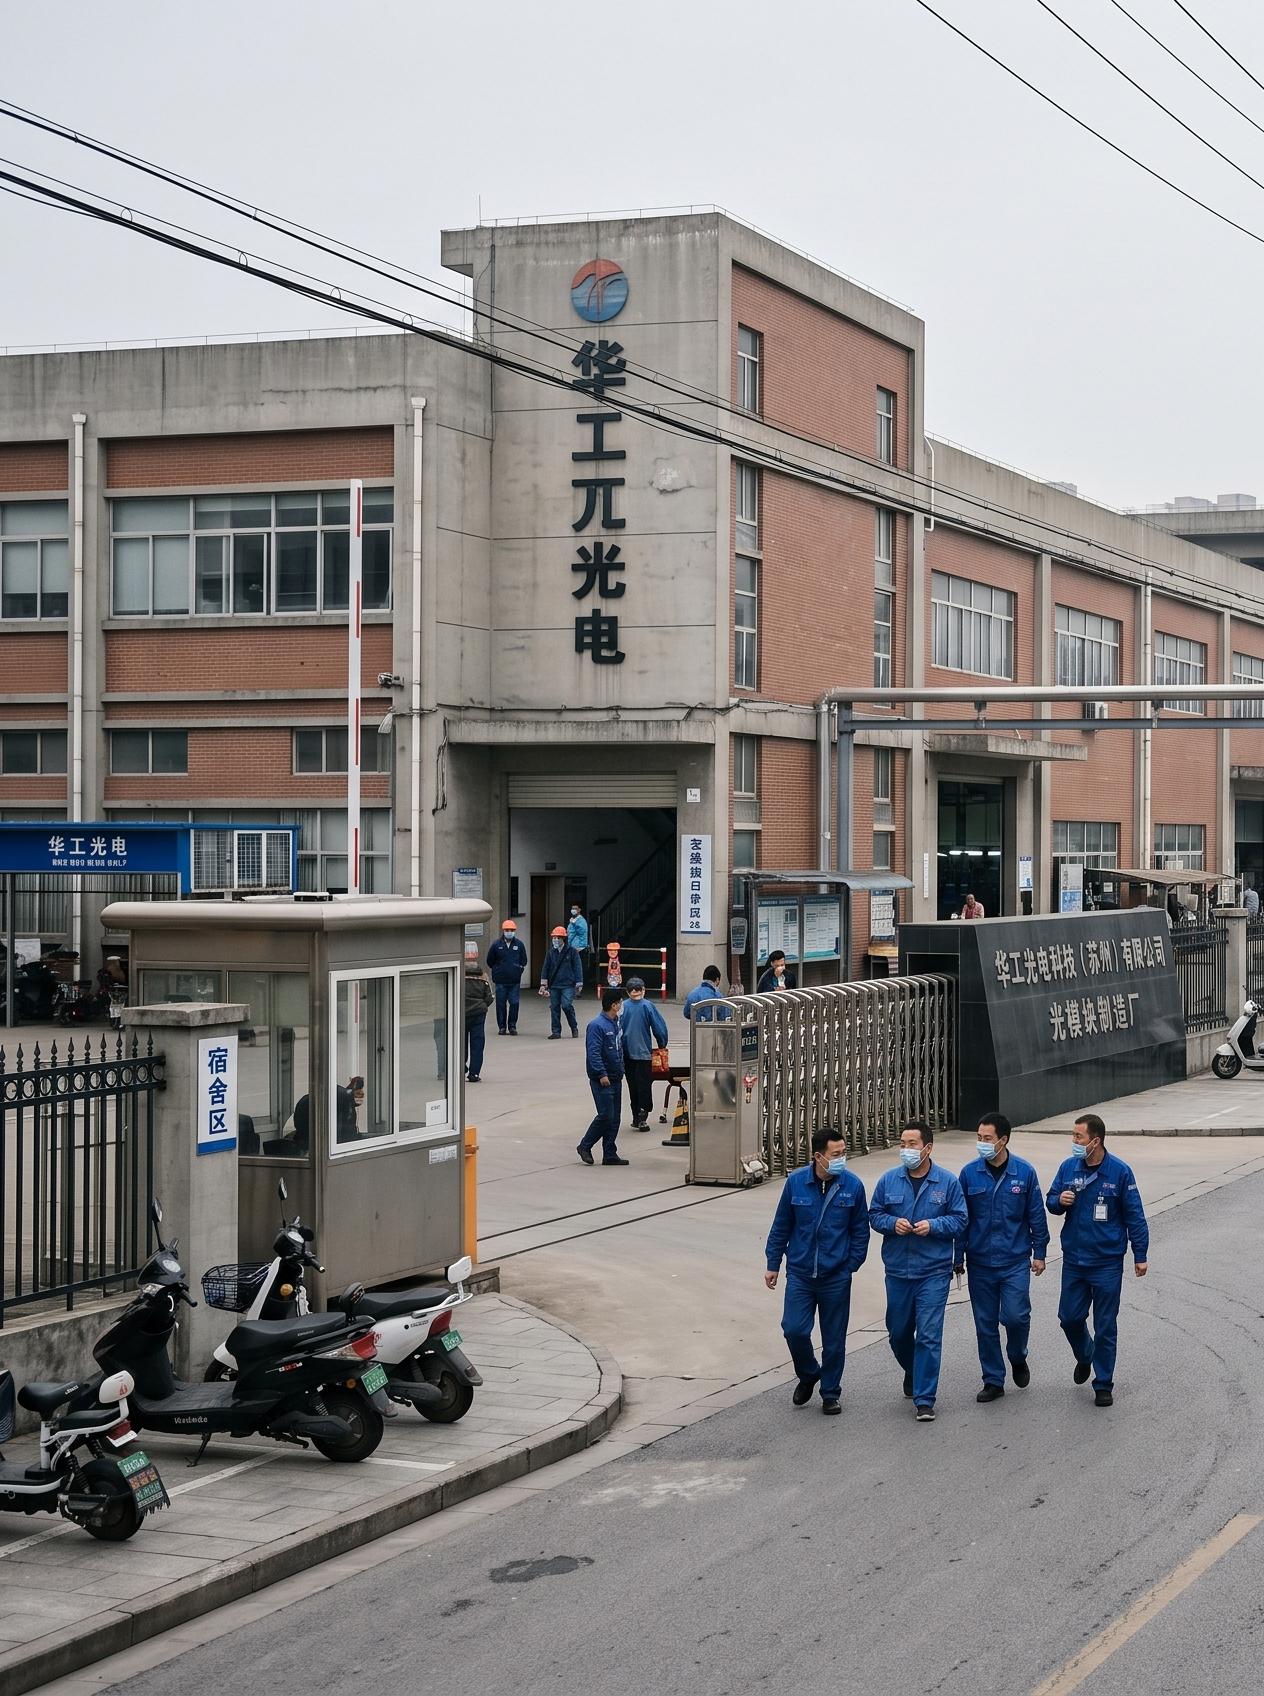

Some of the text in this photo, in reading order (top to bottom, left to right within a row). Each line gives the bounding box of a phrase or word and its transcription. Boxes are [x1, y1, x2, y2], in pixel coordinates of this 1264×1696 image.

[48, 836, 127, 856] 华工光电
[1049, 993, 1140, 1042] 光模块制造厂
[207, 1046, 229, 1136] 宿舍区
